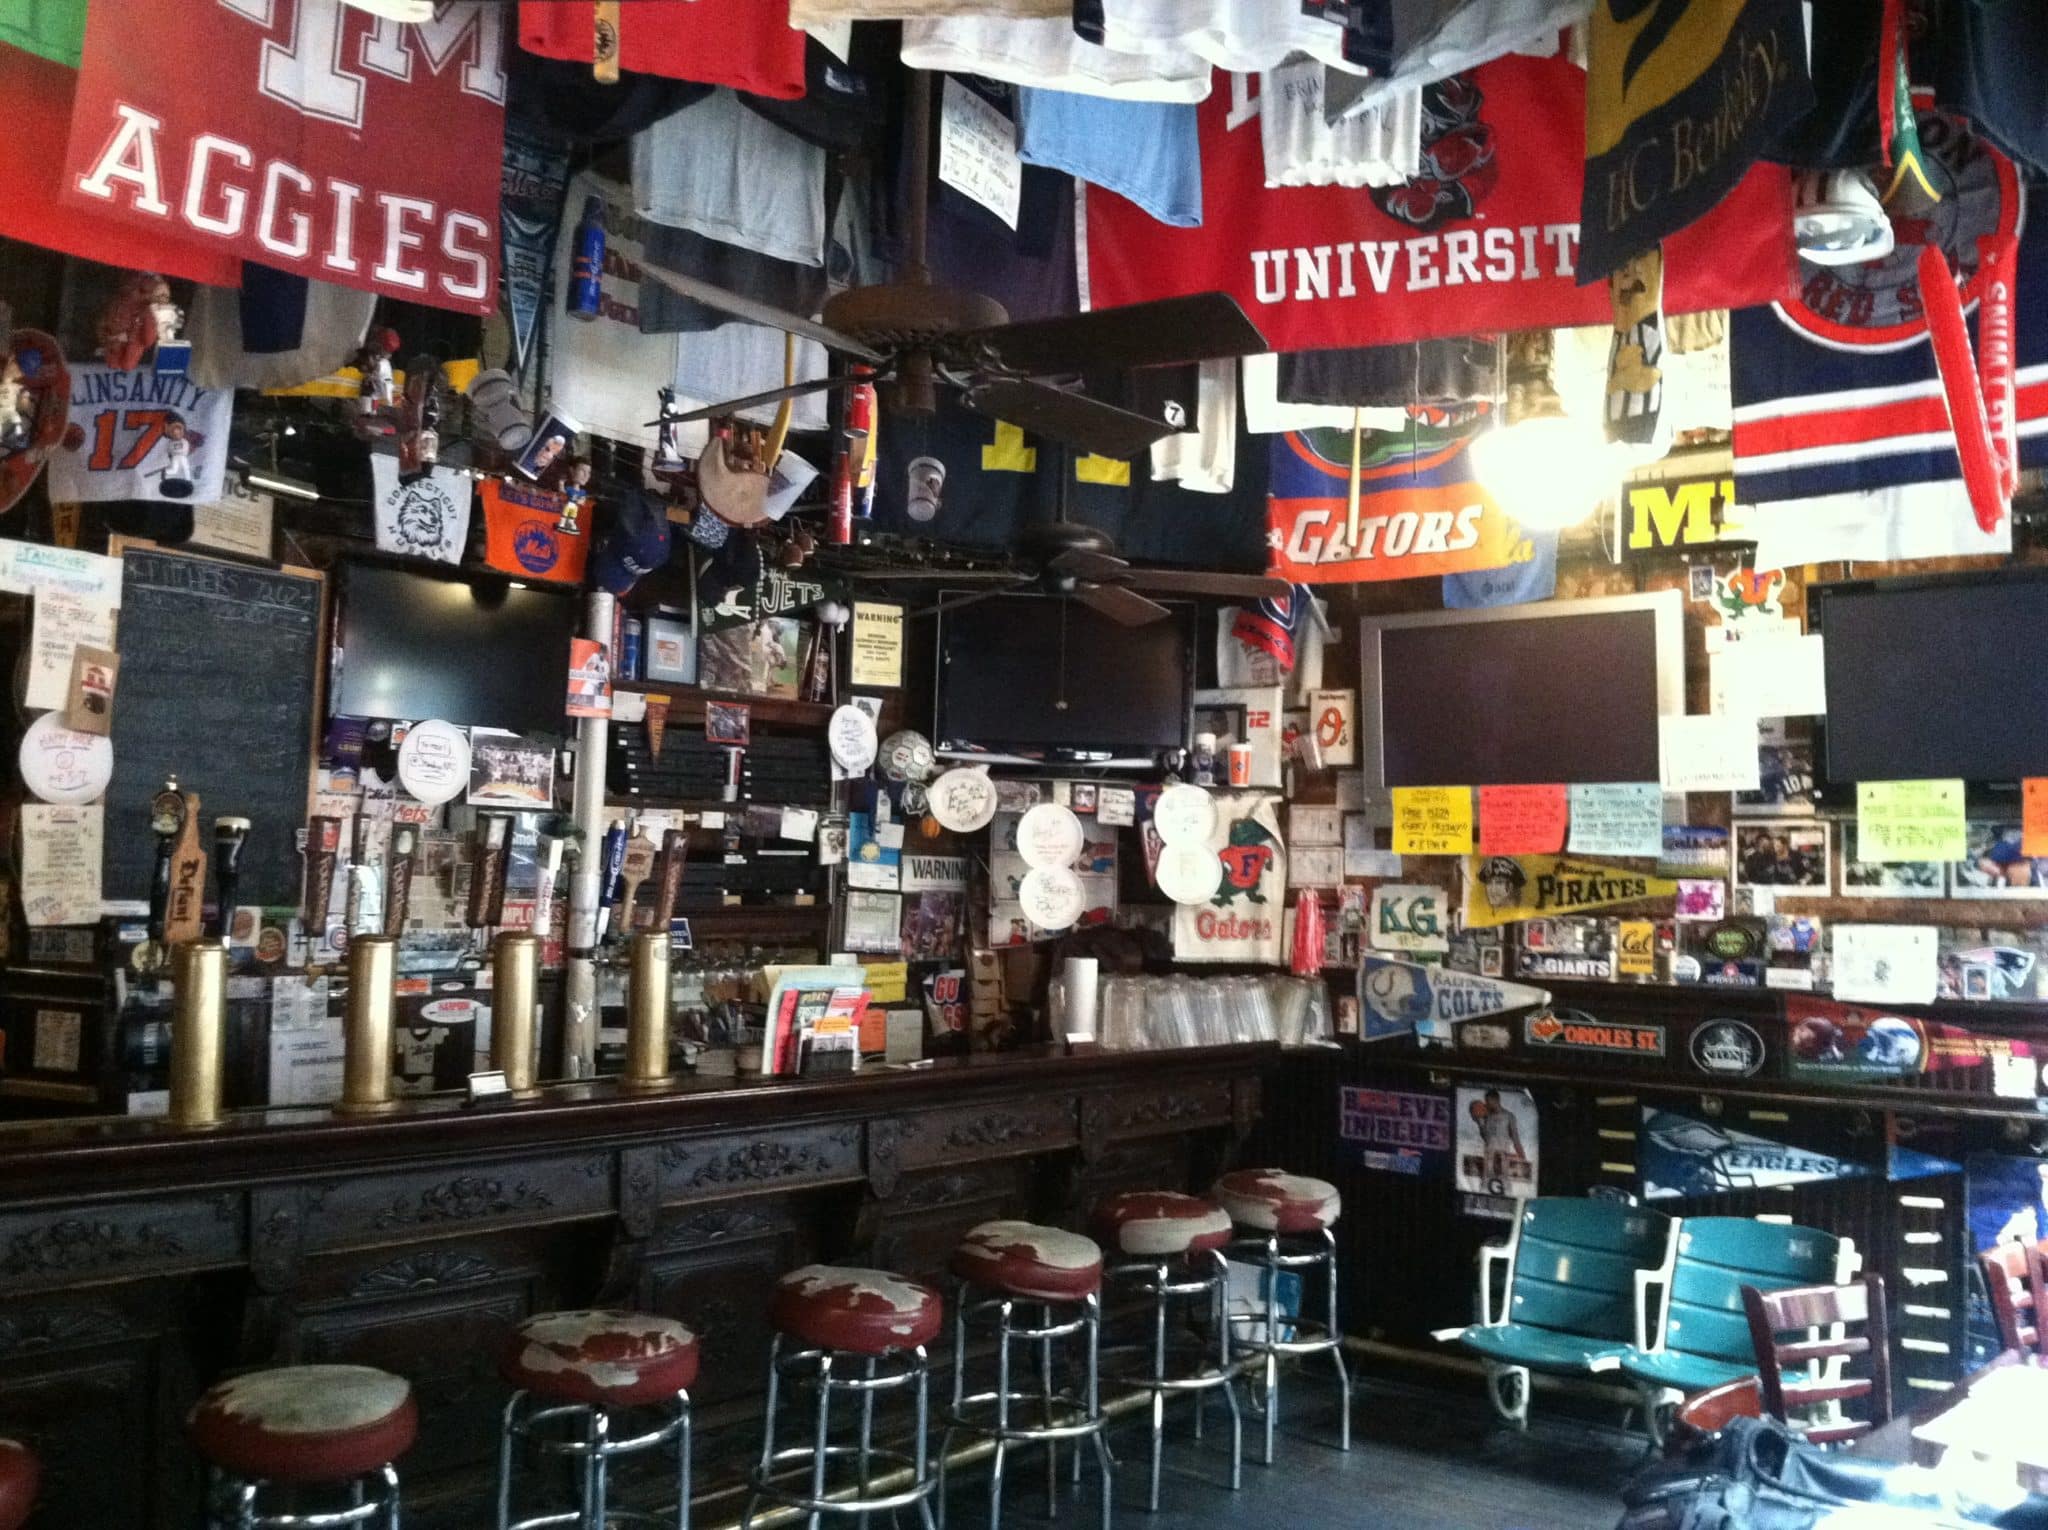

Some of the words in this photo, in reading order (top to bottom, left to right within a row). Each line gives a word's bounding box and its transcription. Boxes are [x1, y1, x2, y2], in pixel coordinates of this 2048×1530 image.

[78, 103, 489, 301] AGGIES
[1250, 222, 1581, 305] UNIVERSIT
[70, 369, 207, 413] LINSANITY
[88, 408, 174, 472] 17
[387, 480, 458, 521] CONNECTICUT
[1286, 504, 1484, 566] GATORS
[760, 579, 825, 614] JETS
[856, 611, 900, 625] WARNING
[1237, 853, 1262, 878] F
[173, 858, 200, 922] Defiant
[1535, 873, 1647, 910] PIRATES
[1196, 909, 1273, 941] Gators
[1621, 930, 1653, 954] Cal
[1544, 957, 1610, 977] GIANTS
[1438, 988, 1505, 1020] COLTS
[1564, 1024, 1633, 1049] ORIOLES
[1702, 1046, 1752, 1069] STONE
[1729, 1152, 1839, 1175] EAGLES
